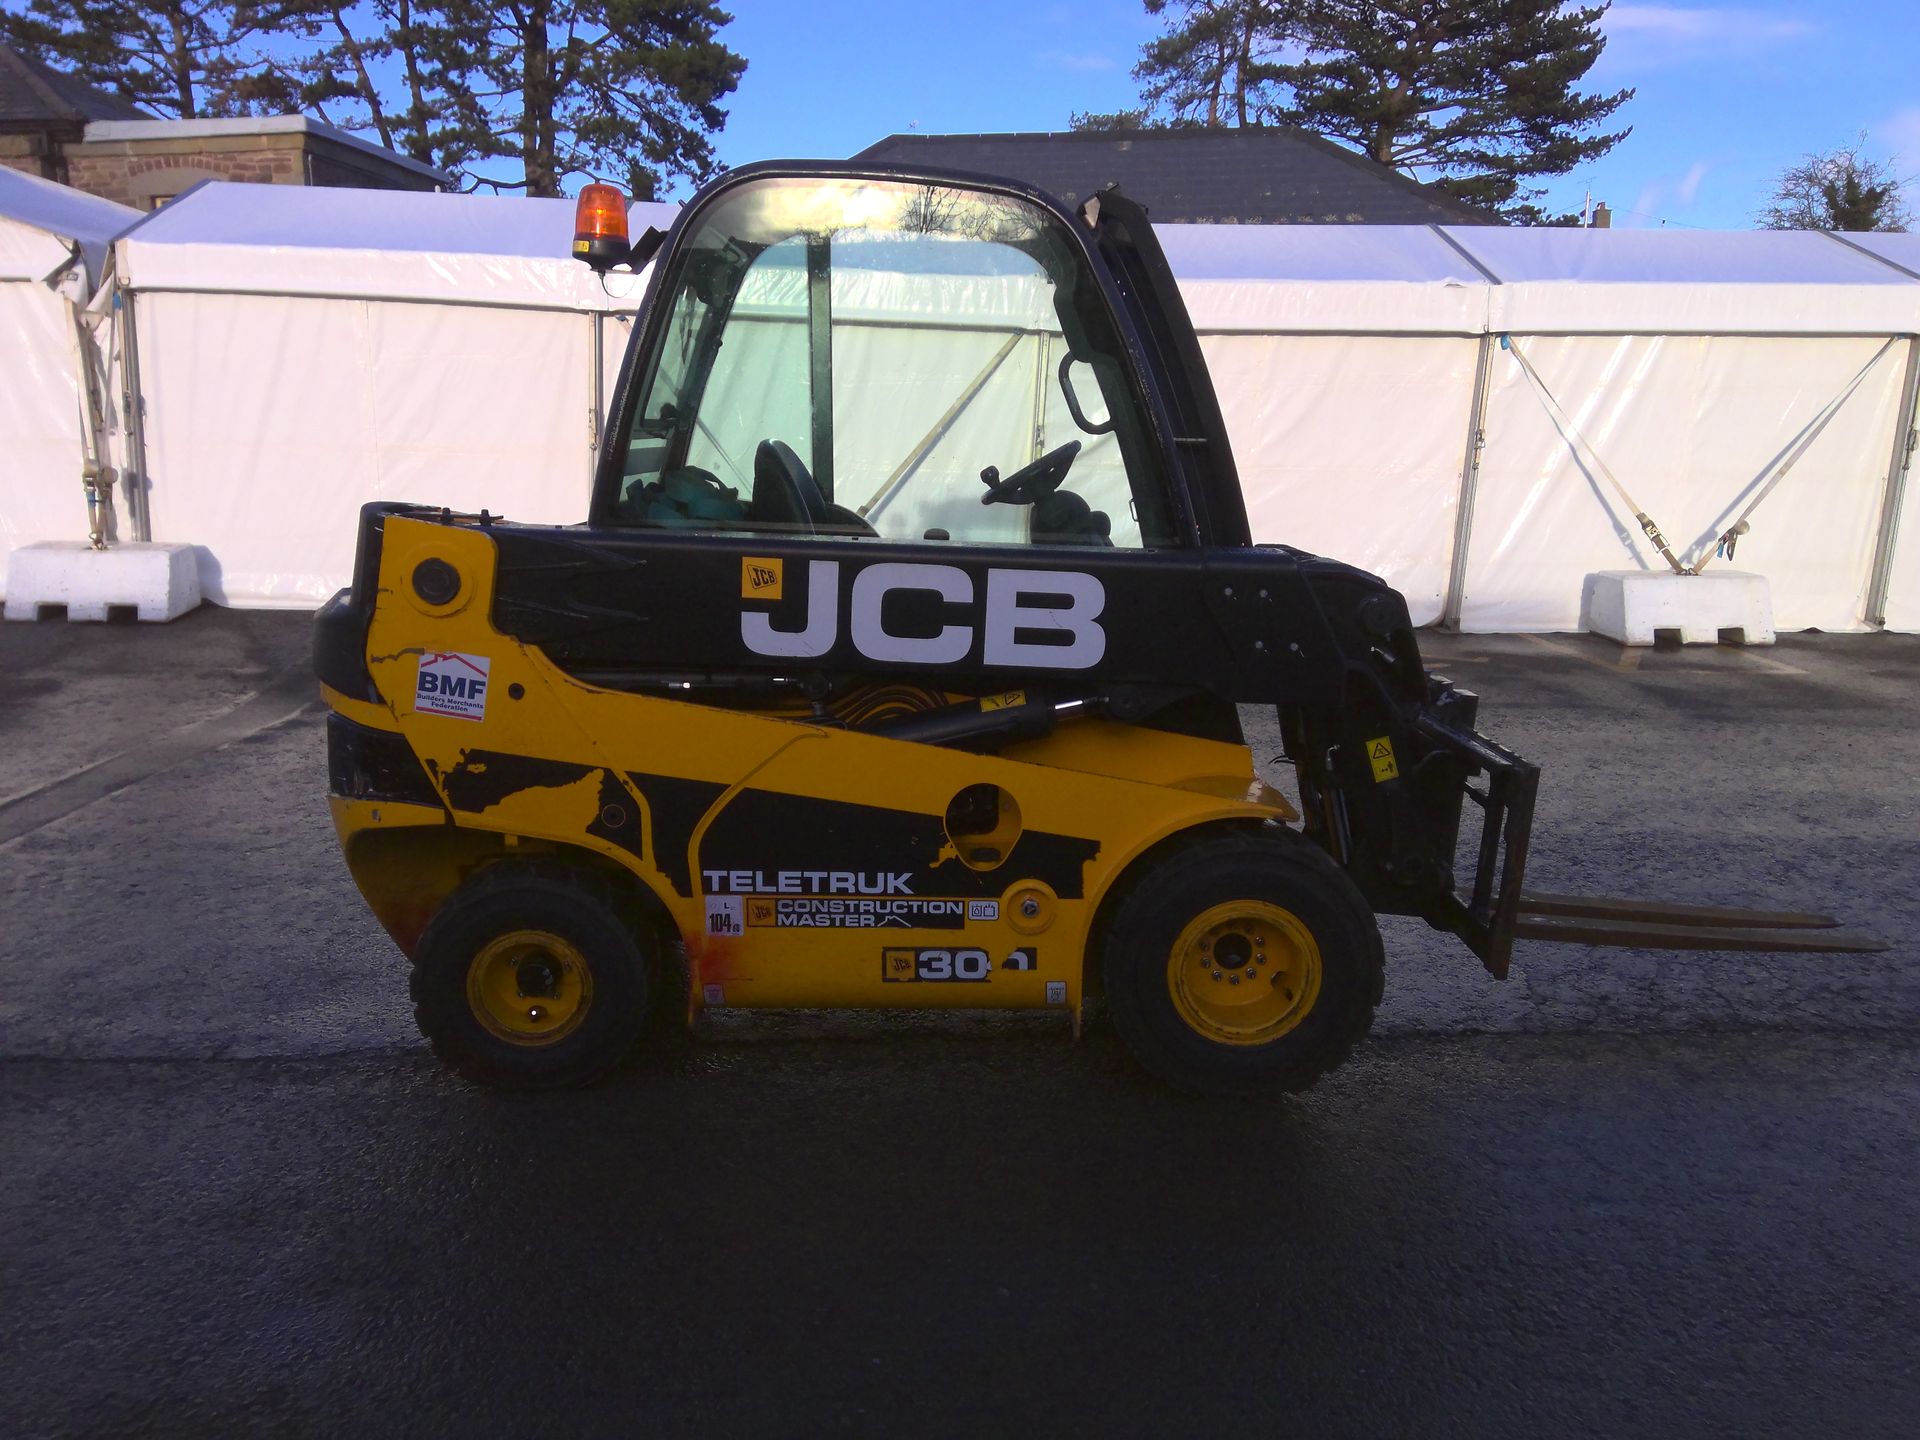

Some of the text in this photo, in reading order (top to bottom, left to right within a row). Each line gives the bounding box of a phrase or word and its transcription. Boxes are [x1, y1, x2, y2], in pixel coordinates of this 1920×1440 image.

[752, 567, 775, 587] JCB
[741, 559, 1106, 670] JCB
[418, 671, 486, 700] BMF
[416, 693, 484, 708] Builders Merchants
[431, 702, 468, 711] Federation
[703, 870, 914, 894] TELETRUK
[777, 900, 964, 915] CONSTRUCTION
[709, 913, 731, 933] 104
[777, 913, 875, 928] MASTER
